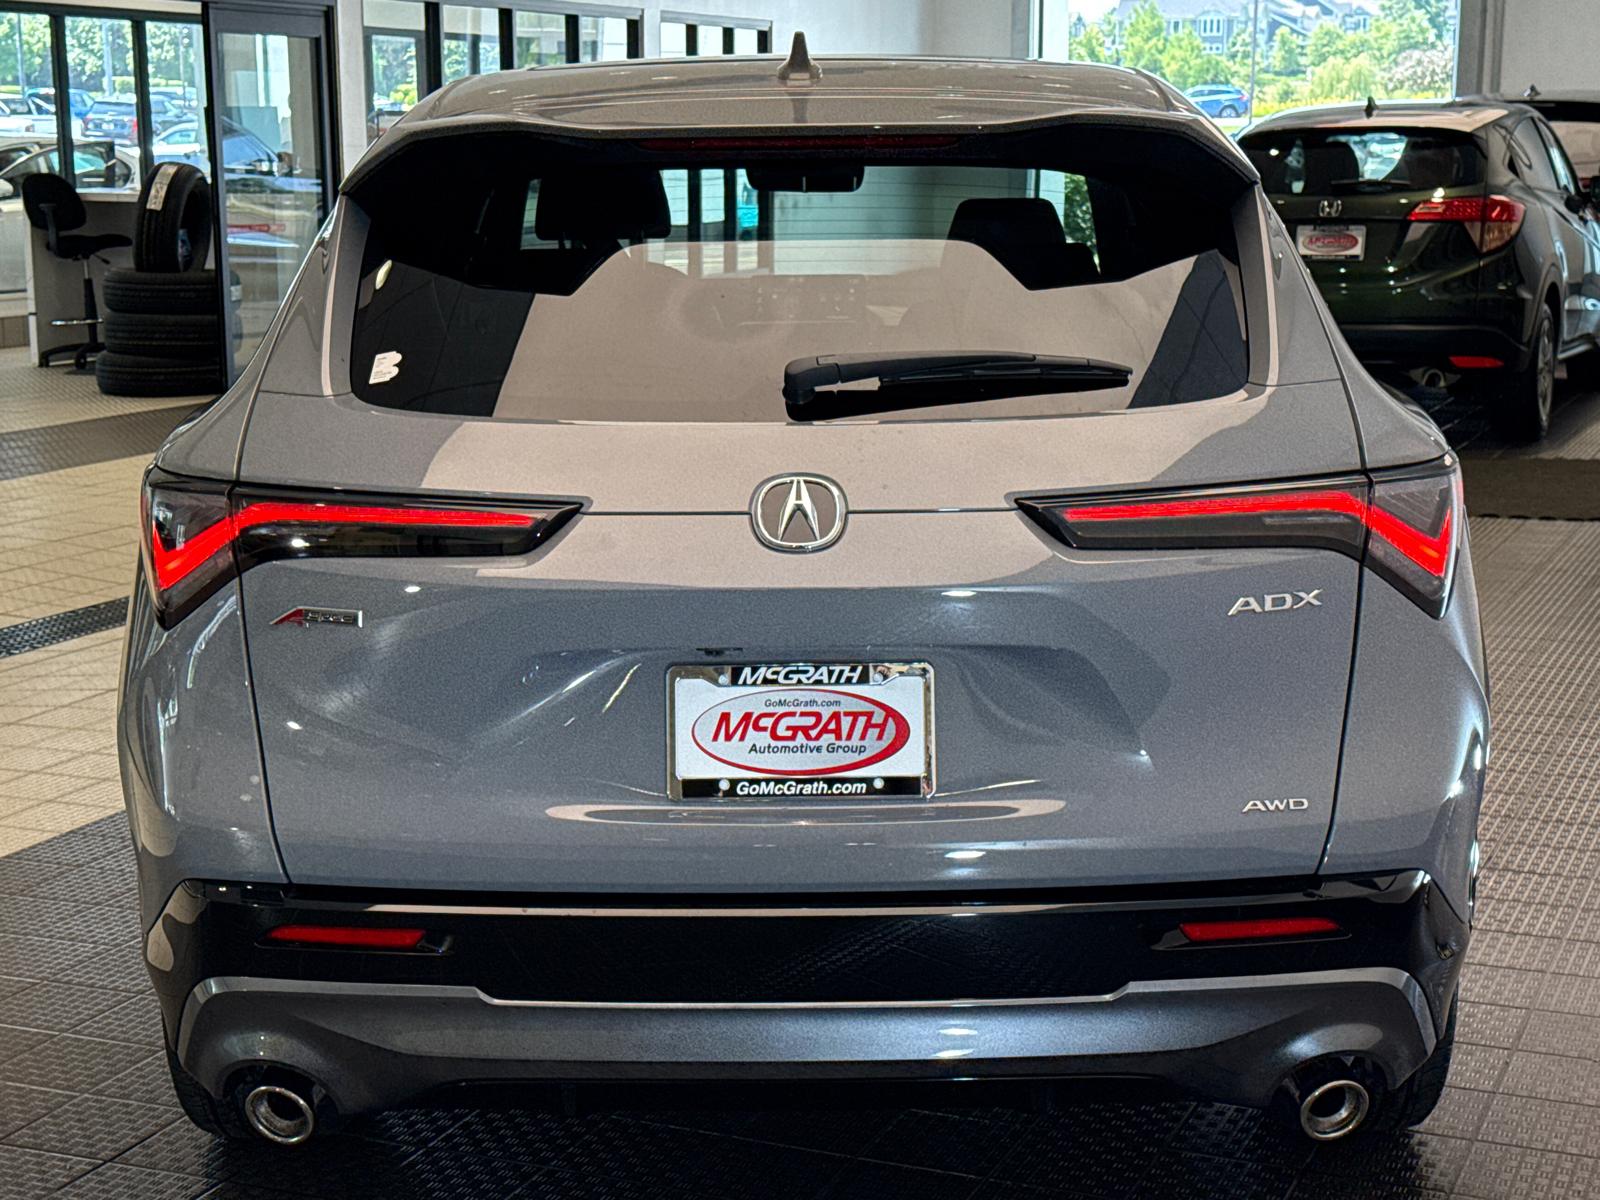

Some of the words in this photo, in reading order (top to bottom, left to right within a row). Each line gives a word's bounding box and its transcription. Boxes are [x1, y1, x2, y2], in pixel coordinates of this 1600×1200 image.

[1227, 589, 1323, 616] ADX
[737, 666, 863, 685] McGRATH
[764, 698, 841, 708] GoMcGrath.com
[711, 711, 892, 742] McGRATH
[748, 742, 823, 755] Automotive
[826, 743, 867, 756] Group
[736, 780, 867, 795] GoMcGrath.com
[1241, 798, 1309, 813] AWD
